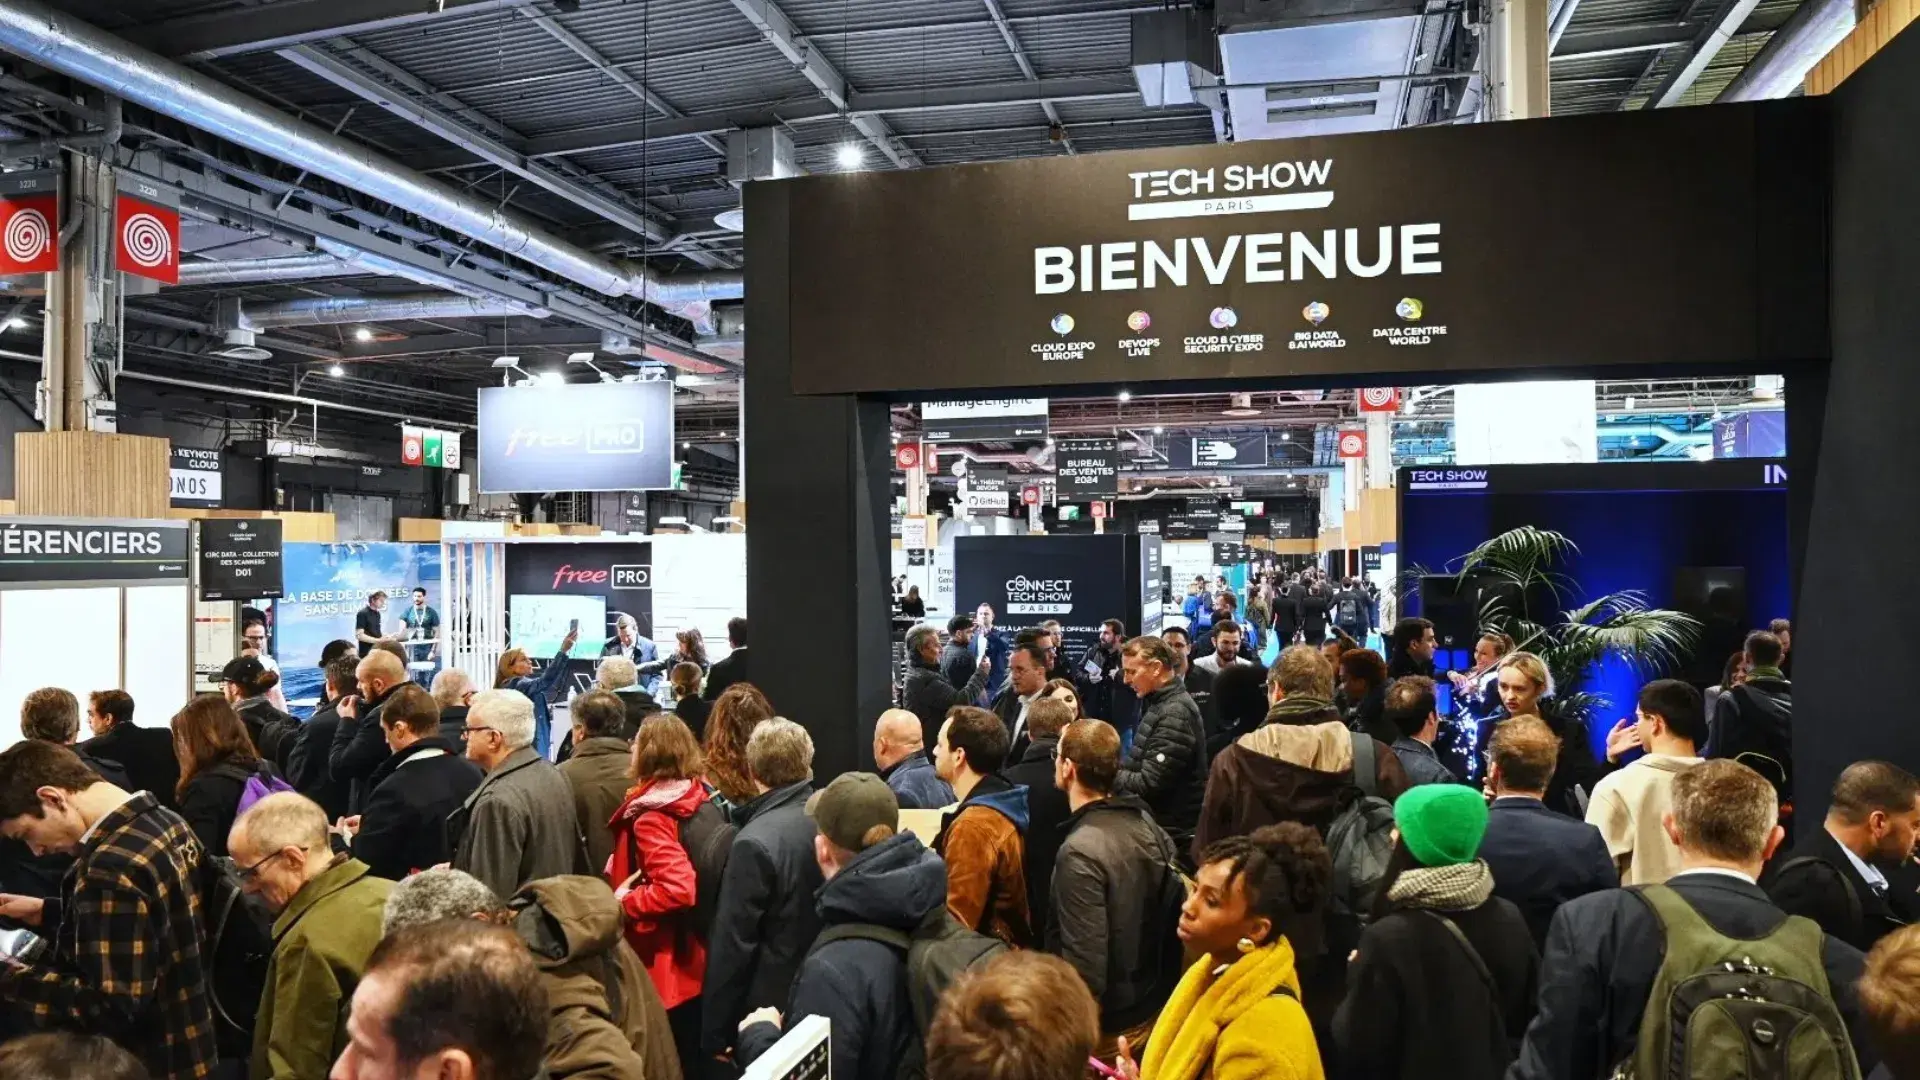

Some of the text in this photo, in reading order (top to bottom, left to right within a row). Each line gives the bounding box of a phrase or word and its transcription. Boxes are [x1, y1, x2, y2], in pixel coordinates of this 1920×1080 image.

[1128, 159, 1333, 198] TECH SHOW
[1204, 200, 1254, 212] PARIS
[1034, 223, 1442, 294] BIENVENUE
[1294, 331, 1339, 341] BIG DATA
[1373, 326, 1447, 337] DATA CENTRE
[1118, 338, 1160, 348] DEVOPS
[1184, 335, 1218, 345] CLOUD
[1229, 334, 1264, 344] CYBER
[1307, 339, 1346, 348] WORLD
[1388, 336, 1431, 345] WORLD
[1031, 341, 1095, 352] CLOUD EXPO
[1128, 348, 1150, 356] LIVE
[1184, 343, 1264, 354] SECURITY EXPO
[1042, 351, 1084, 360] EUROPE
[178, 449, 218, 460] KEYNOTE
[189, 459, 218, 469] CLOUD
[1067, 459, 1105, 467] BUREAU
[1059, 467, 1114, 476] DES VENTES
[1410, 470, 1487, 481] TECH SHOW
[0, 524, 162, 554] ÉRENCIERS
[552, 564, 647, 590] free PRO
[1006, 575, 1072, 591] CONNECT
[300, 590, 333, 602] BASE
[337, 590, 353, 600] DE
[1007, 592, 1072, 601] TECH SHOW
[305, 603, 339, 616] SANS
[1020, 604, 1059, 612] PARIS
